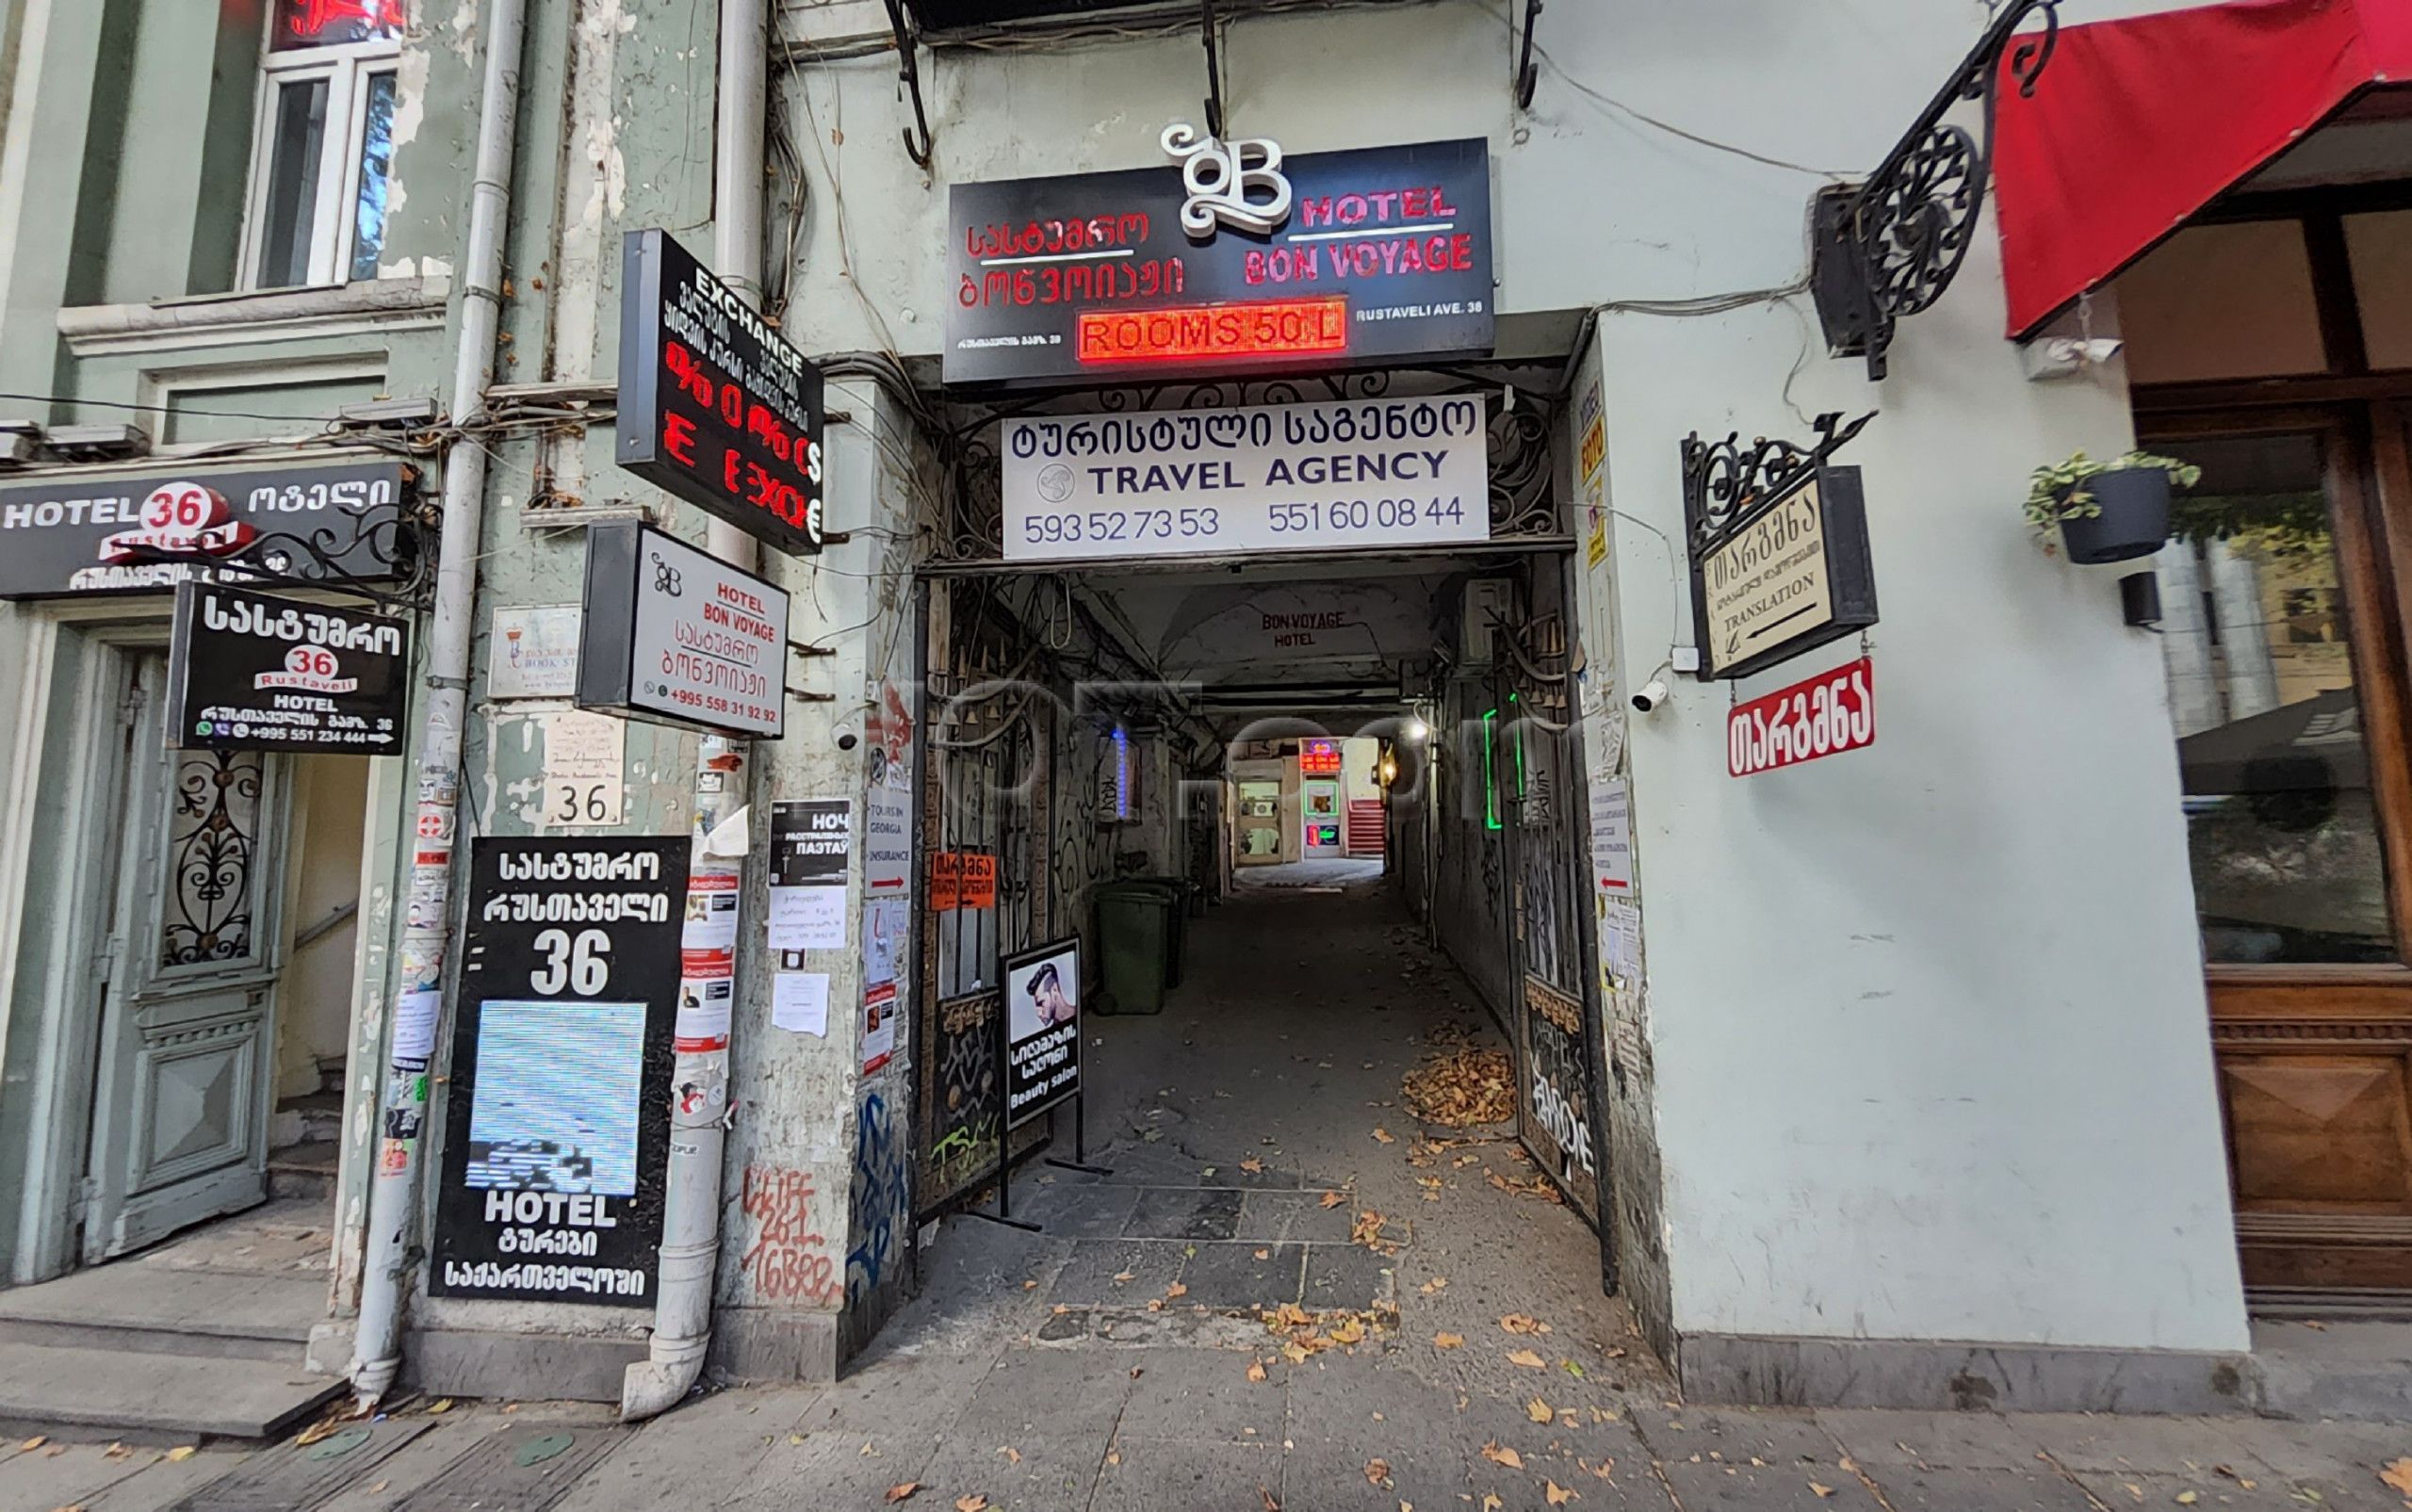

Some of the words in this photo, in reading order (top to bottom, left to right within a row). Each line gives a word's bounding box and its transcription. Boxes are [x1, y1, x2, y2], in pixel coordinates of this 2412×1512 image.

[1301, 186, 1457, 227] HOTEL
[967, 212, 1149, 258] სასტუმრო
[1245, 244, 1317, 285] BON
[1330, 234, 1473, 279] VOYAGE
[959, 257, 1183, 308] ბონვოიაჟი
[696, 267, 803, 377] EXCHANGE
[1357, 304, 1431, 321] RUSTAVELI
[1434, 302, 1464, 316] AVE.
[1083, 313, 1241, 352] ROOMS
[1012, 410, 1271, 459] ტურისტული
[1284, 399, 1476, 444] საგენტო
[1087, 461, 1246, 494] TRAVEL
[1265, 450, 1449, 486] AGENCY
[4, 496, 139, 528] HOTEL
[148, 490, 202, 528] 36
[249, 480, 390, 512] ოტელი
[1269, 502, 1319, 532] 551
[1329, 500, 1368, 529] 60
[1377, 498, 1415, 528] 08
[1426, 496, 1464, 526] 44
[1026, 514, 1081, 543] 593
[1714, 491, 1816, 590] თარგმნა
[718, 582, 765, 614] HOTEL
[1724, 572, 1815, 631] TRANSLATION
[204, 595, 400, 656] სასტუმრო
[705, 603, 729, 626] BON
[733, 613, 774, 642] VOYAGE
[1263, 613, 1289, 630] BON
[1291, 611, 1345, 629] VOYAGE
[675, 619, 758, 664] სასტუმრო
[1275, 633, 1316, 648] HOTEL
[291, 650, 334, 675] 36
[662, 650, 766, 698] ბონვოიაჟი
[261, 675, 352, 691] Rustaveli
[201, 707, 318, 726] რუსთაველის
[377, 719, 393, 730] 36
[274, 694, 338, 711] HOTEL
[671, 690, 702, 707] +995
[731, 702, 744, 716] 31
[747, 705, 760, 720] 92
[763, 709, 775, 723] 92
[251, 727, 286, 740] +995
[290, 729, 314, 740] 551
[318, 730, 341, 742] 234
[344, 731, 366, 742] 444
[1730, 671, 1870, 774] თარგმნა
[559, 785, 606, 821] 36
[812, 814, 848, 830] НОЧ
[871, 822, 902, 834] GEORGIA
[499, 852, 659, 881] სასტუმრო
[870, 851, 909, 861] INSURANCE
[484, 892, 668, 922] რუსთაველი
[530, 929, 611, 996] 36
[1010, 1081, 1049, 1109] Beauty
[1051, 1065, 1077, 1088] salon
[485, 1190, 616, 1227] HOTEL
[498, 1230, 597, 1256] ტურები
[445, 1260, 645, 1296] საქართველოში
